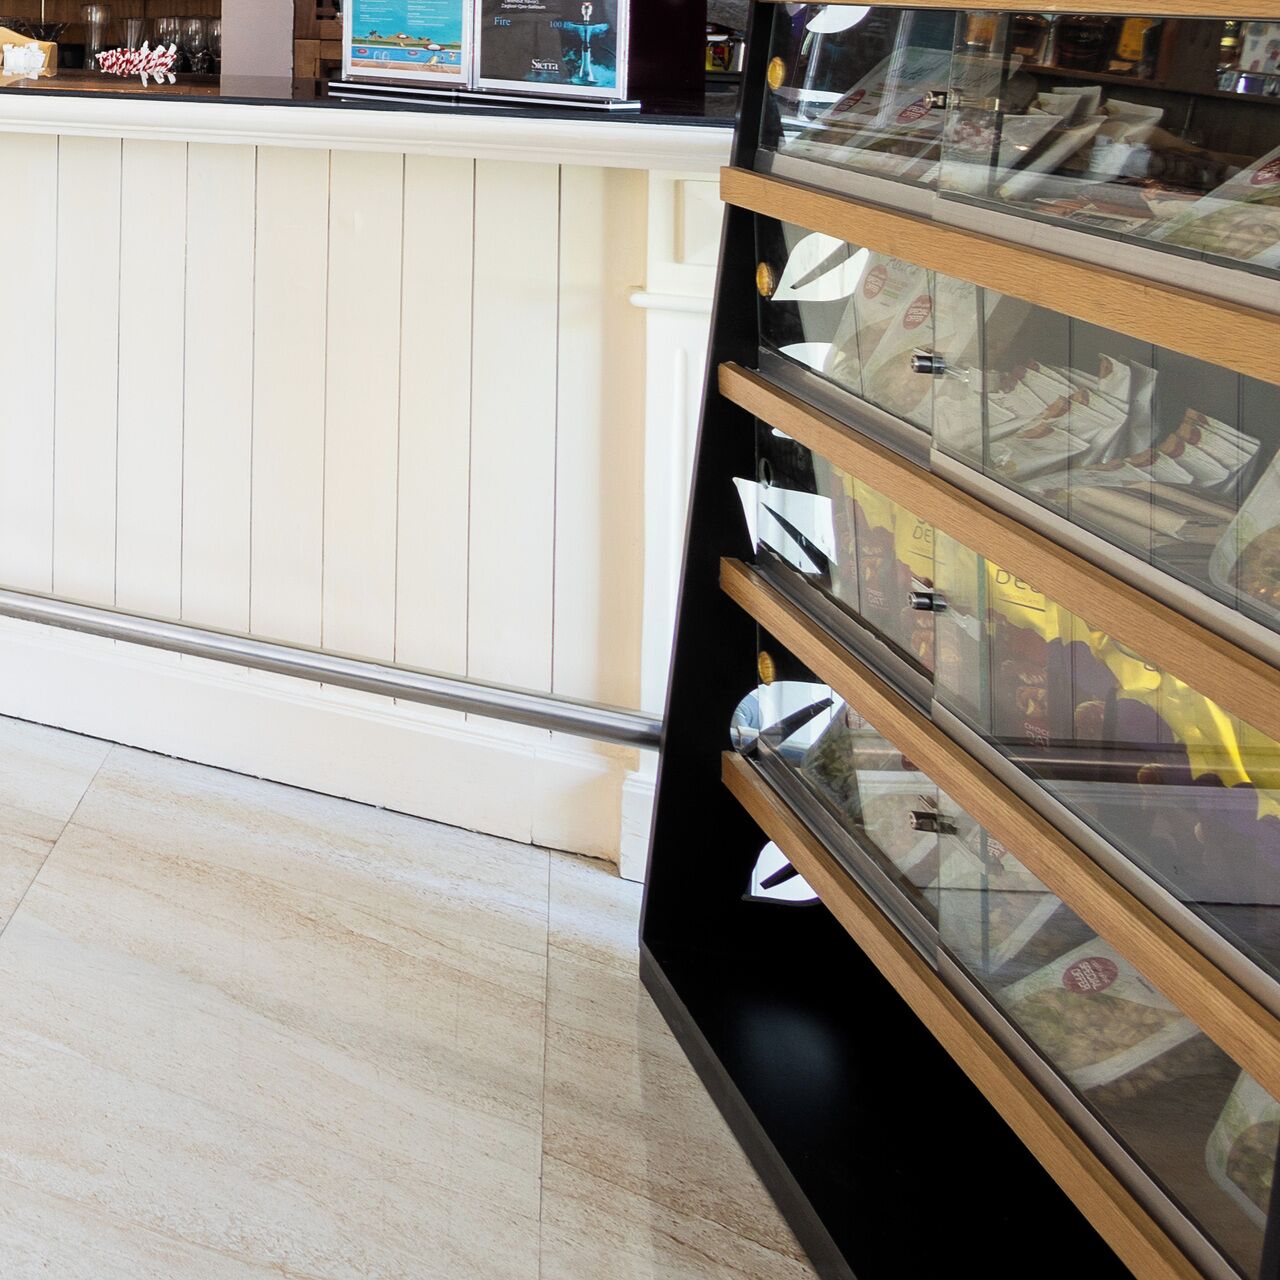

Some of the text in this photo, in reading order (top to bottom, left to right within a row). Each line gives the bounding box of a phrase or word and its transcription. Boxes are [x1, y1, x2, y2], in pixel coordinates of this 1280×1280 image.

[494, 16, 512, 25] Fire
[531, 59, 559, 70] Sierra
[1071, 968, 1091, 991] OFFER
[1080, 961, 1101, 990] SPECIAL
